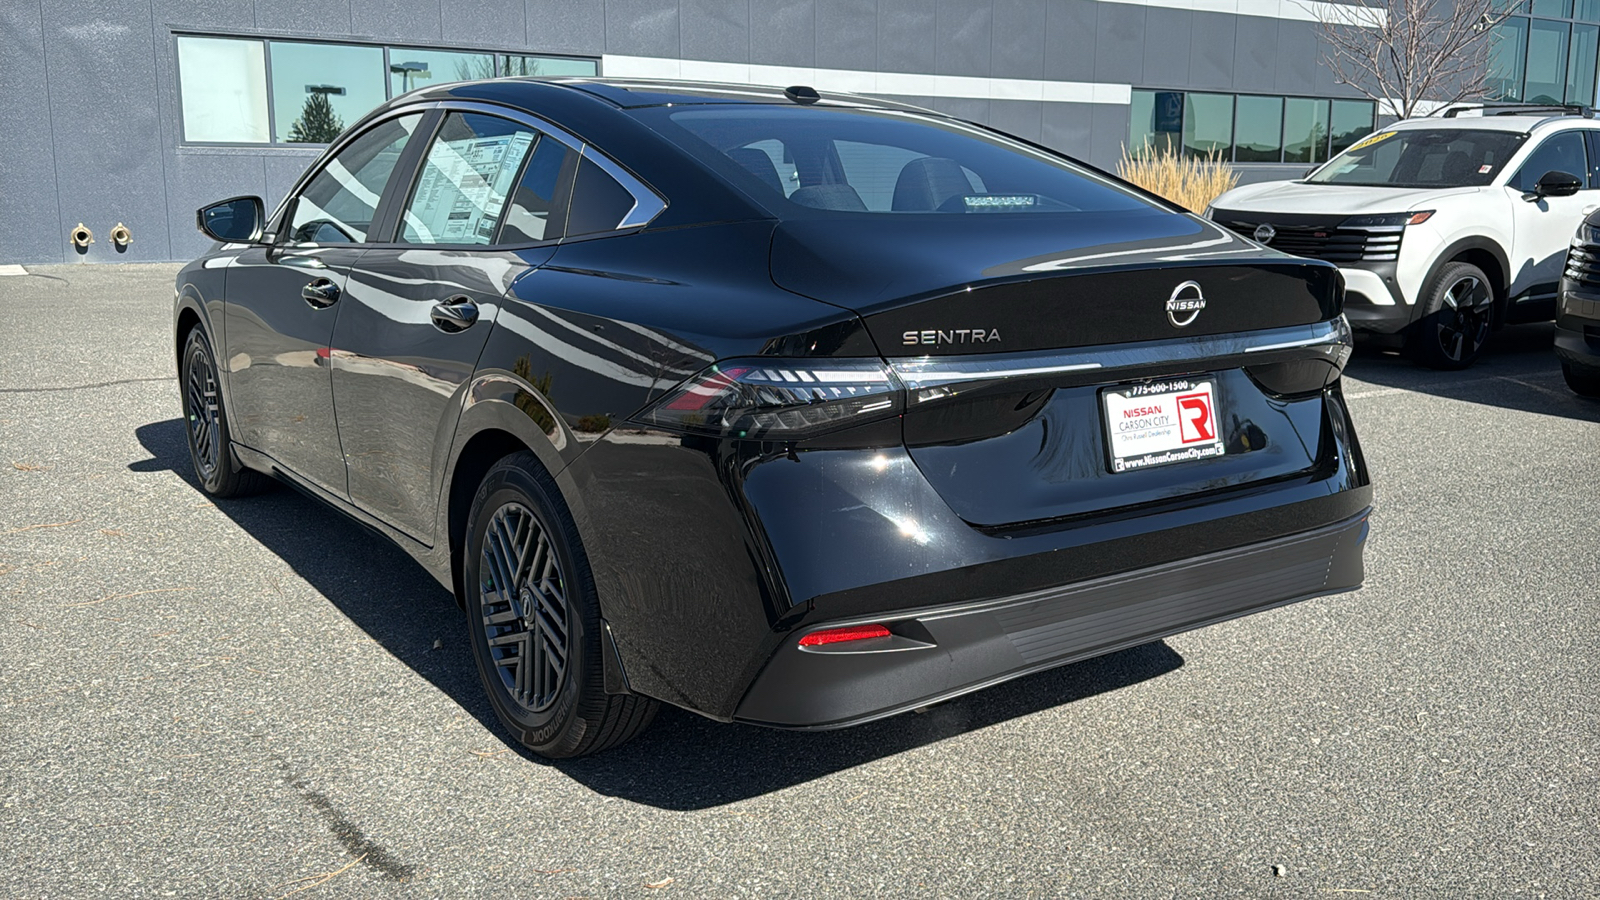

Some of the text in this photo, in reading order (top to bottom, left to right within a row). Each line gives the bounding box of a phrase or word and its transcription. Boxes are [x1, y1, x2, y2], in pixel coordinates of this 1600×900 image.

[1166, 299, 1206, 311] NISSAN
[902, 328, 1001, 346] SENTRA
[1132, 380, 1189, 396] 775-600-1500
[1123, 405, 1162, 419] NISSAN
[1119, 415, 1170, 431] CARSON CITY
[1124, 447, 1216, 469] www.NissanCarsonCity.com
